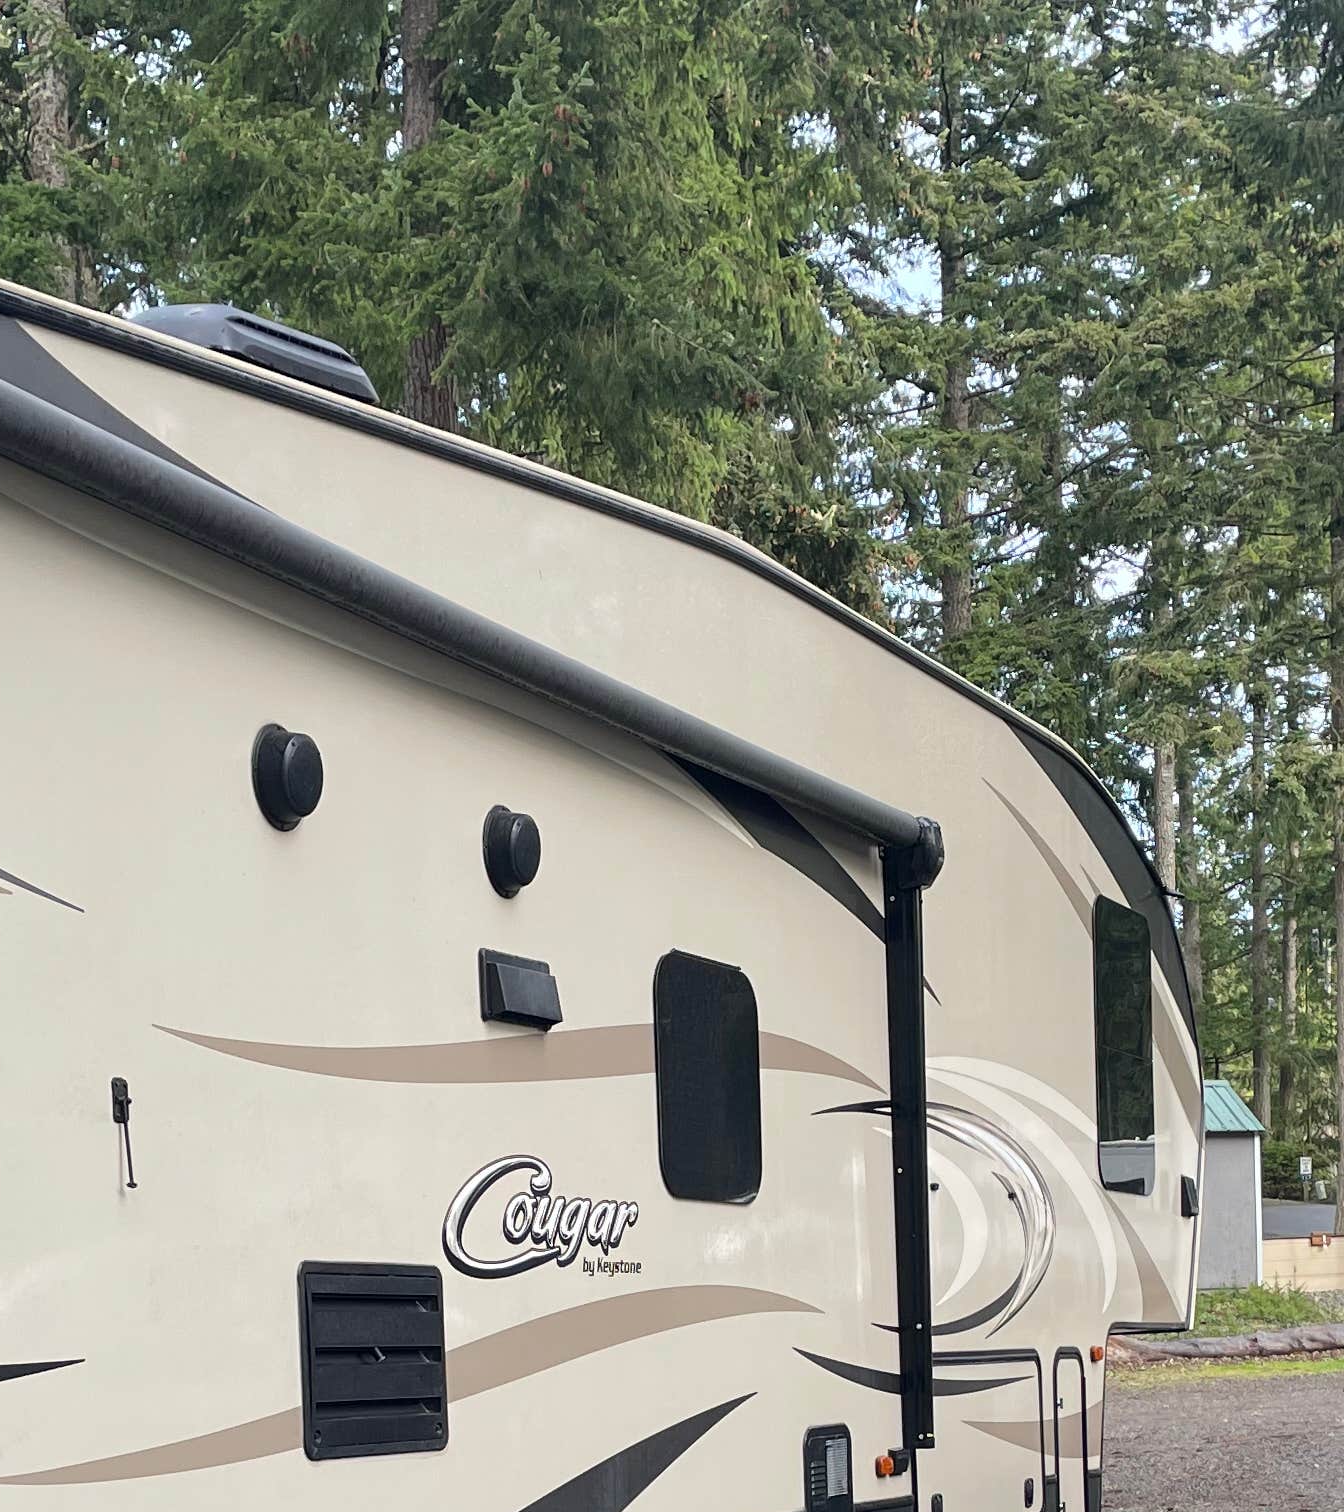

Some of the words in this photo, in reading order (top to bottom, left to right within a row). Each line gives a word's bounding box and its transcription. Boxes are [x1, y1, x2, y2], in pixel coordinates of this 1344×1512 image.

[442, 1155, 640, 1279] Cougar
[582, 1257, 595, 1276] by
[596, 1258, 642, 1277] Keystone
